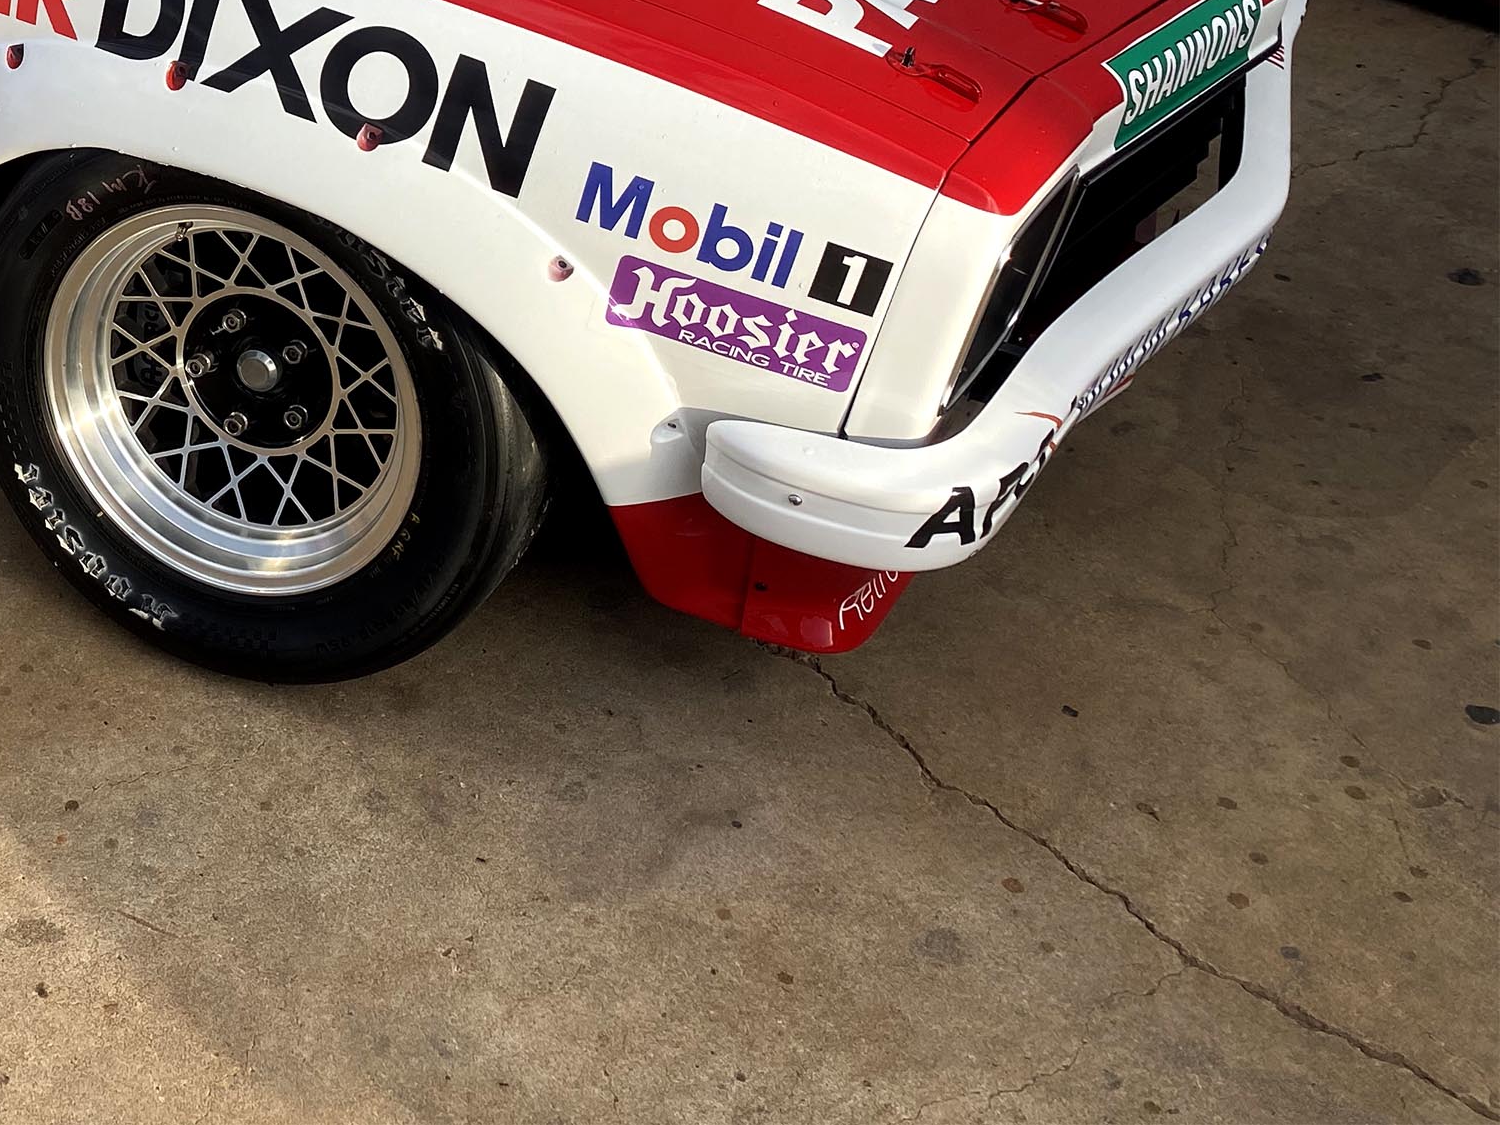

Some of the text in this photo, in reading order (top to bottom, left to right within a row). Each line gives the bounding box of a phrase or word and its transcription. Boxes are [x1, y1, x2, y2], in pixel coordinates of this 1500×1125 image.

[576, 161, 805, 289] Mobil
[610, 266, 858, 374] Hoosier
[678, 329, 832, 388] RACING TIRE
